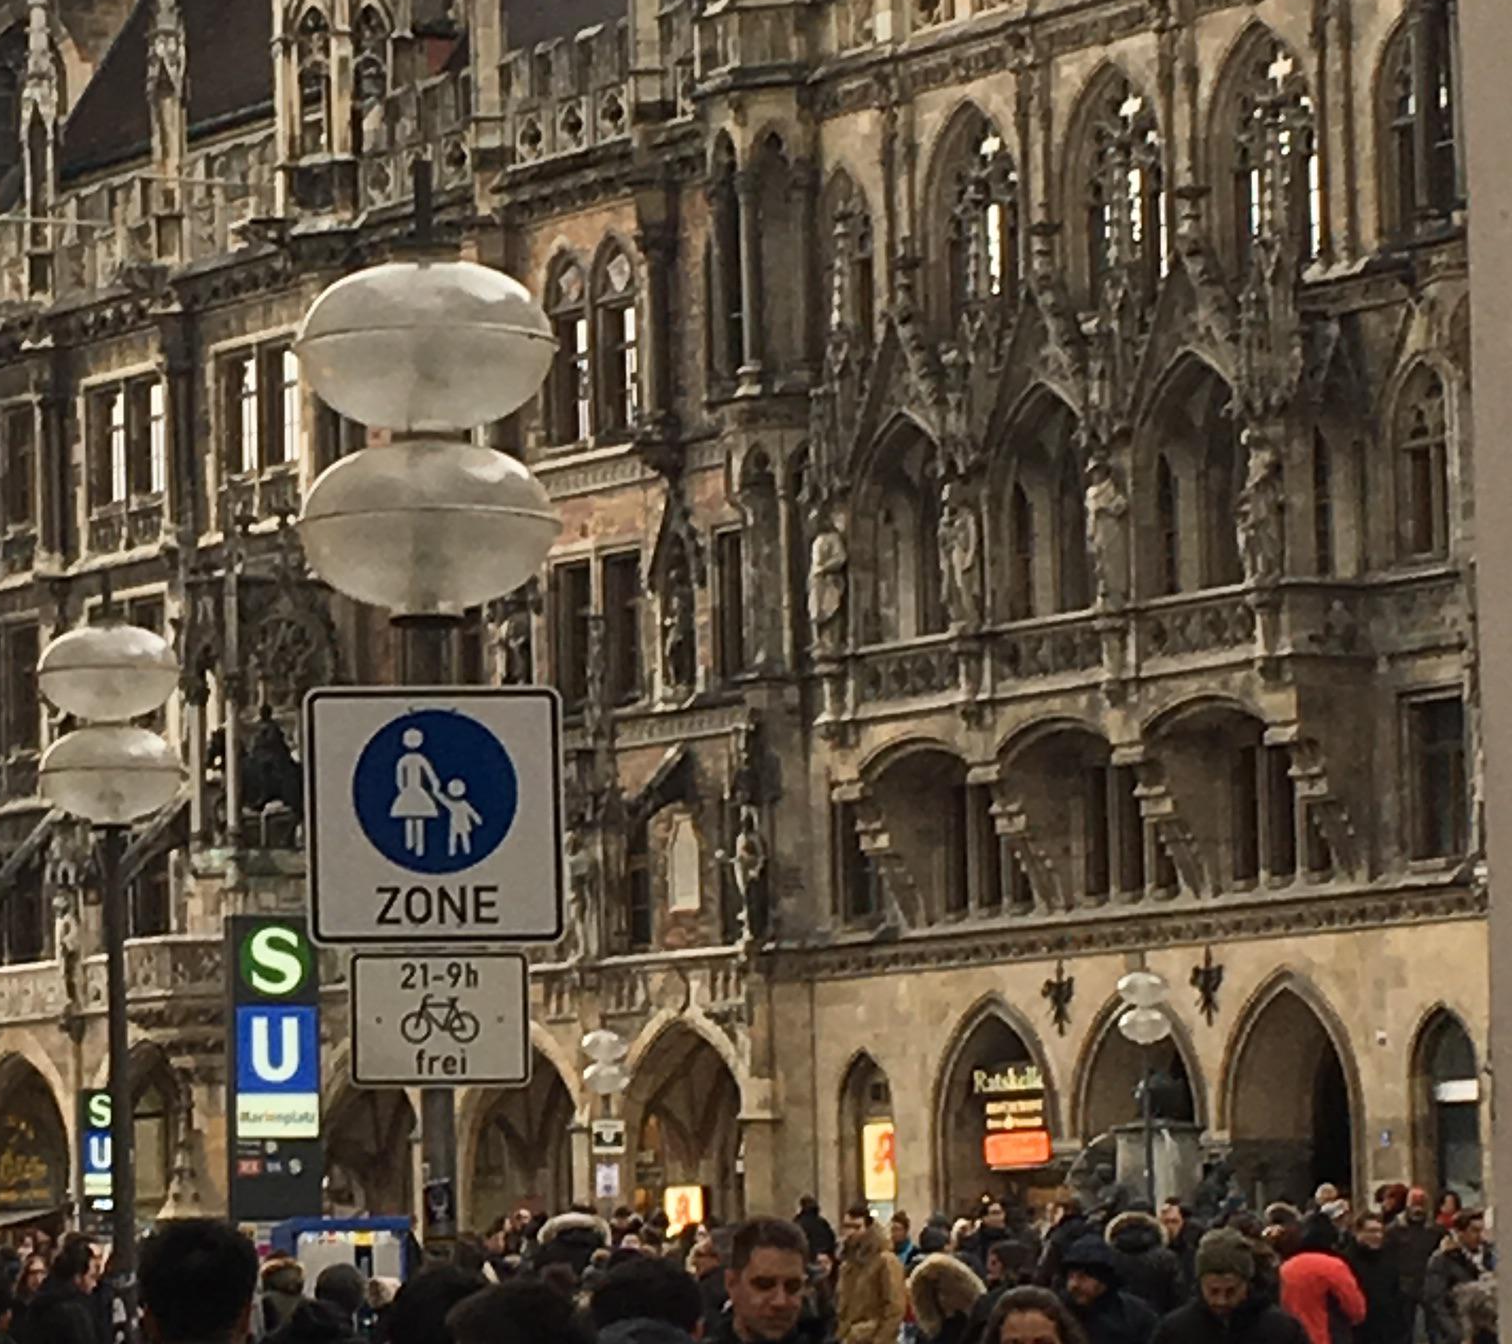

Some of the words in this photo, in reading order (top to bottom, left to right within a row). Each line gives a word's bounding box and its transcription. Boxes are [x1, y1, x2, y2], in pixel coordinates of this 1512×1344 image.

[375, 885, 500, 925] ZONE
[250, 926, 303, 995] S
[400, 961, 479, 990] 21-9h
[251, 1015, 300, 1083] U
[415, 1047, 468, 1076] frei
[89, 1094, 112, 1128] S
[89, 1135, 112, 1169] U
